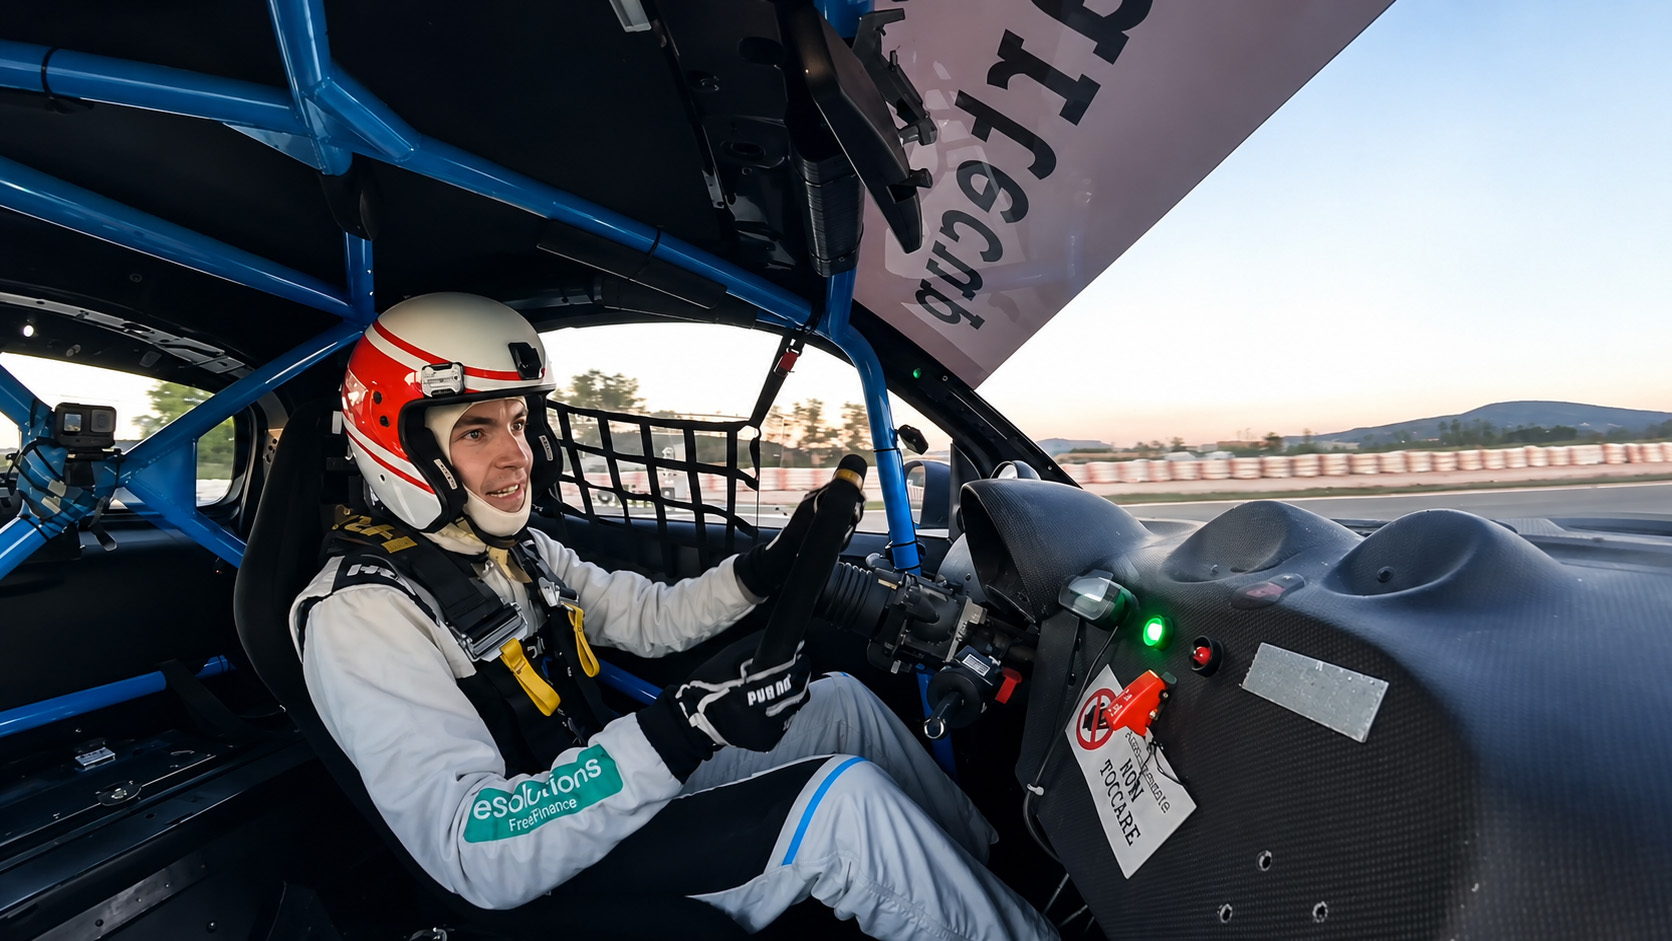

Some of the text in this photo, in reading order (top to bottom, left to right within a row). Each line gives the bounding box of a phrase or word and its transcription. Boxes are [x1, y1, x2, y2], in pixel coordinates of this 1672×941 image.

[1120, 758, 1144, 802] NON
[508, 798, 577, 831] FreeFinance
[1100, 759, 1141, 846] TOCCARE
